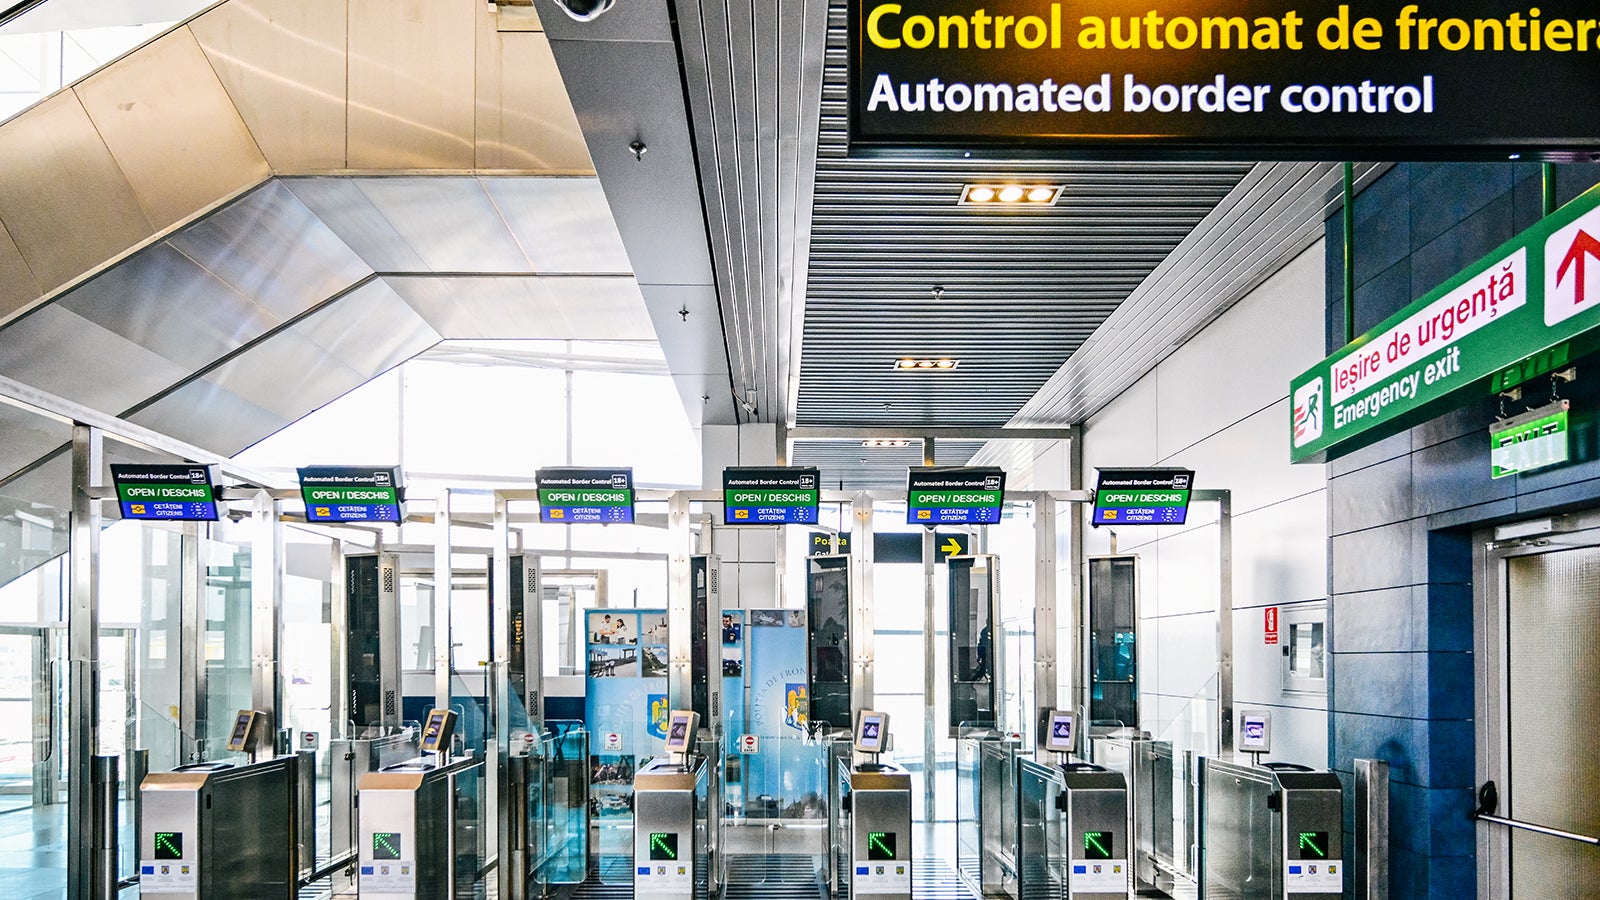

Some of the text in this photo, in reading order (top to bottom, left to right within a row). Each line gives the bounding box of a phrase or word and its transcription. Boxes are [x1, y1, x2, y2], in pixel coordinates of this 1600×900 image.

[867, 3, 1600, 52] Control automat de frontier
[867, 73, 1434, 113] Automated border control
[1387, 332, 1410, 364] de
[1334, 376, 1419, 429] Emergency
[1424, 346, 1460, 385] exit
[1499, 421, 1559, 474] EXIT
[127, 488, 205, 497] OPEN / DESCHIS
[312, 491, 389, 499] OPEN / DESCHIS
[548, 493, 624, 501] OPEN / DESCHIS
[734, 494, 811, 502] OPEN / DESCHIS
[918, 495, 995, 503] OPEN / DESCHIS
[1106, 494, 1182, 502] OPEN / DESCHIS
[815, 536, 847, 545] Poata
